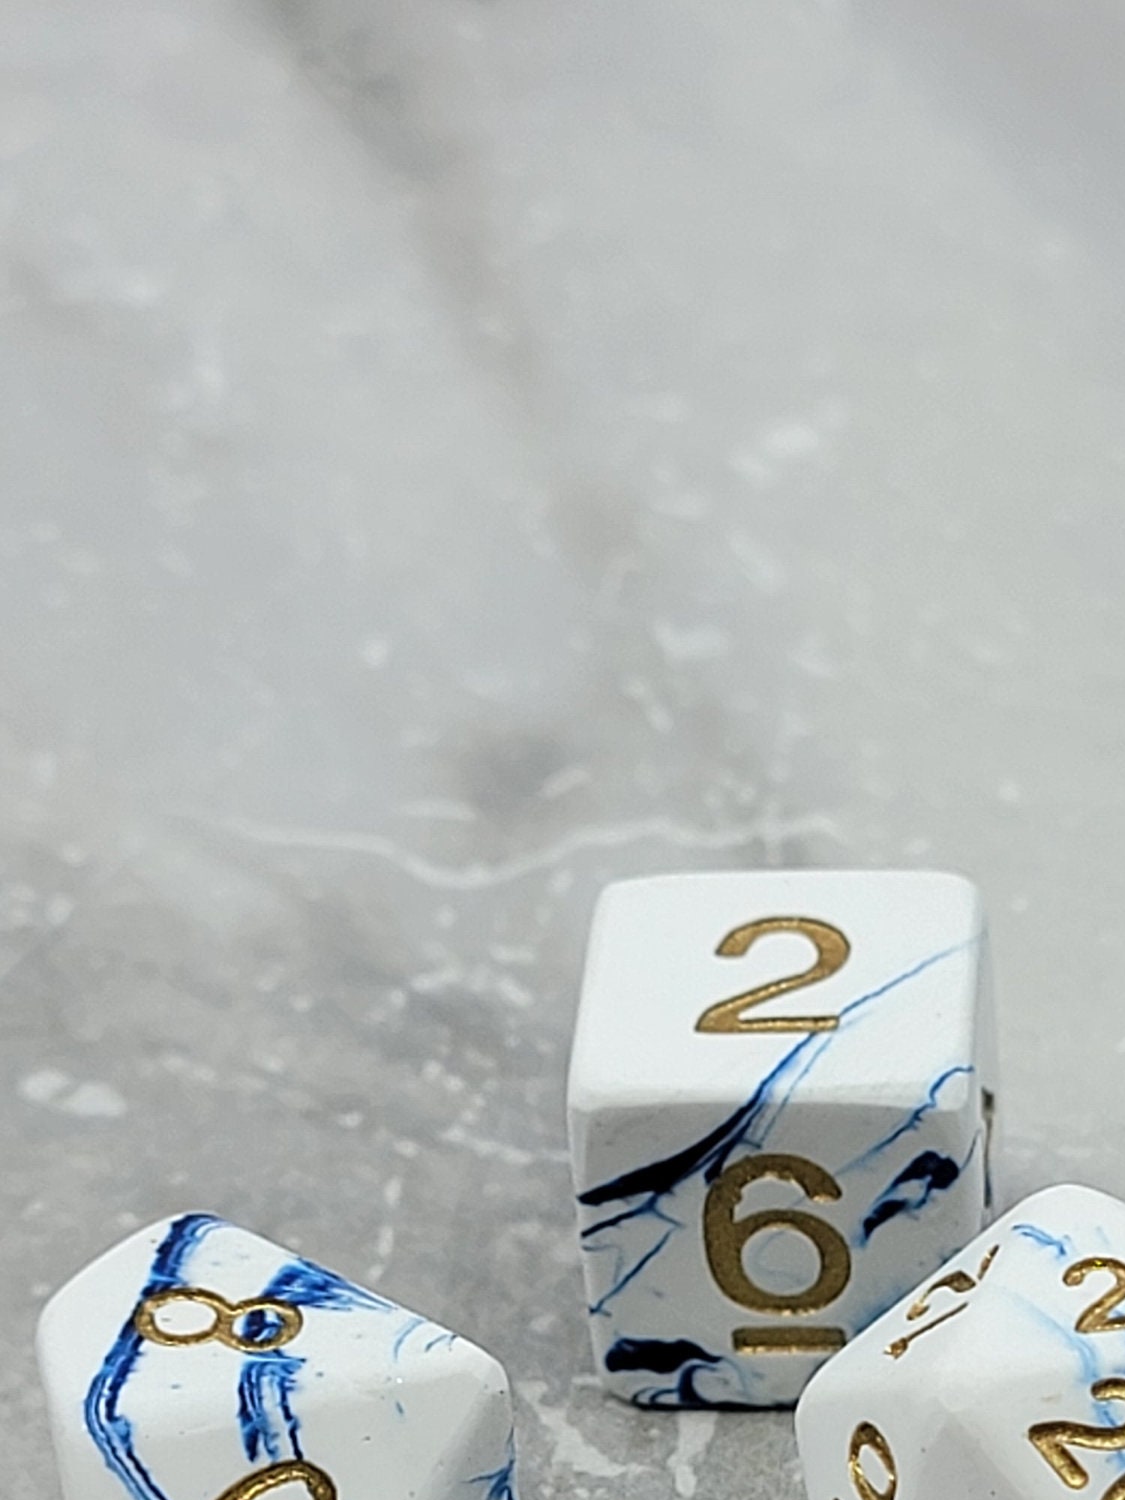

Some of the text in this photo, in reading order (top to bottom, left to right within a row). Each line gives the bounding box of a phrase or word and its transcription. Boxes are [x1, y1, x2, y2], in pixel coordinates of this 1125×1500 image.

[694, 915, 852, 1033] 2
[702, 1152, 853, 1355] 6
[134, 1286, 303, 1353] 8
